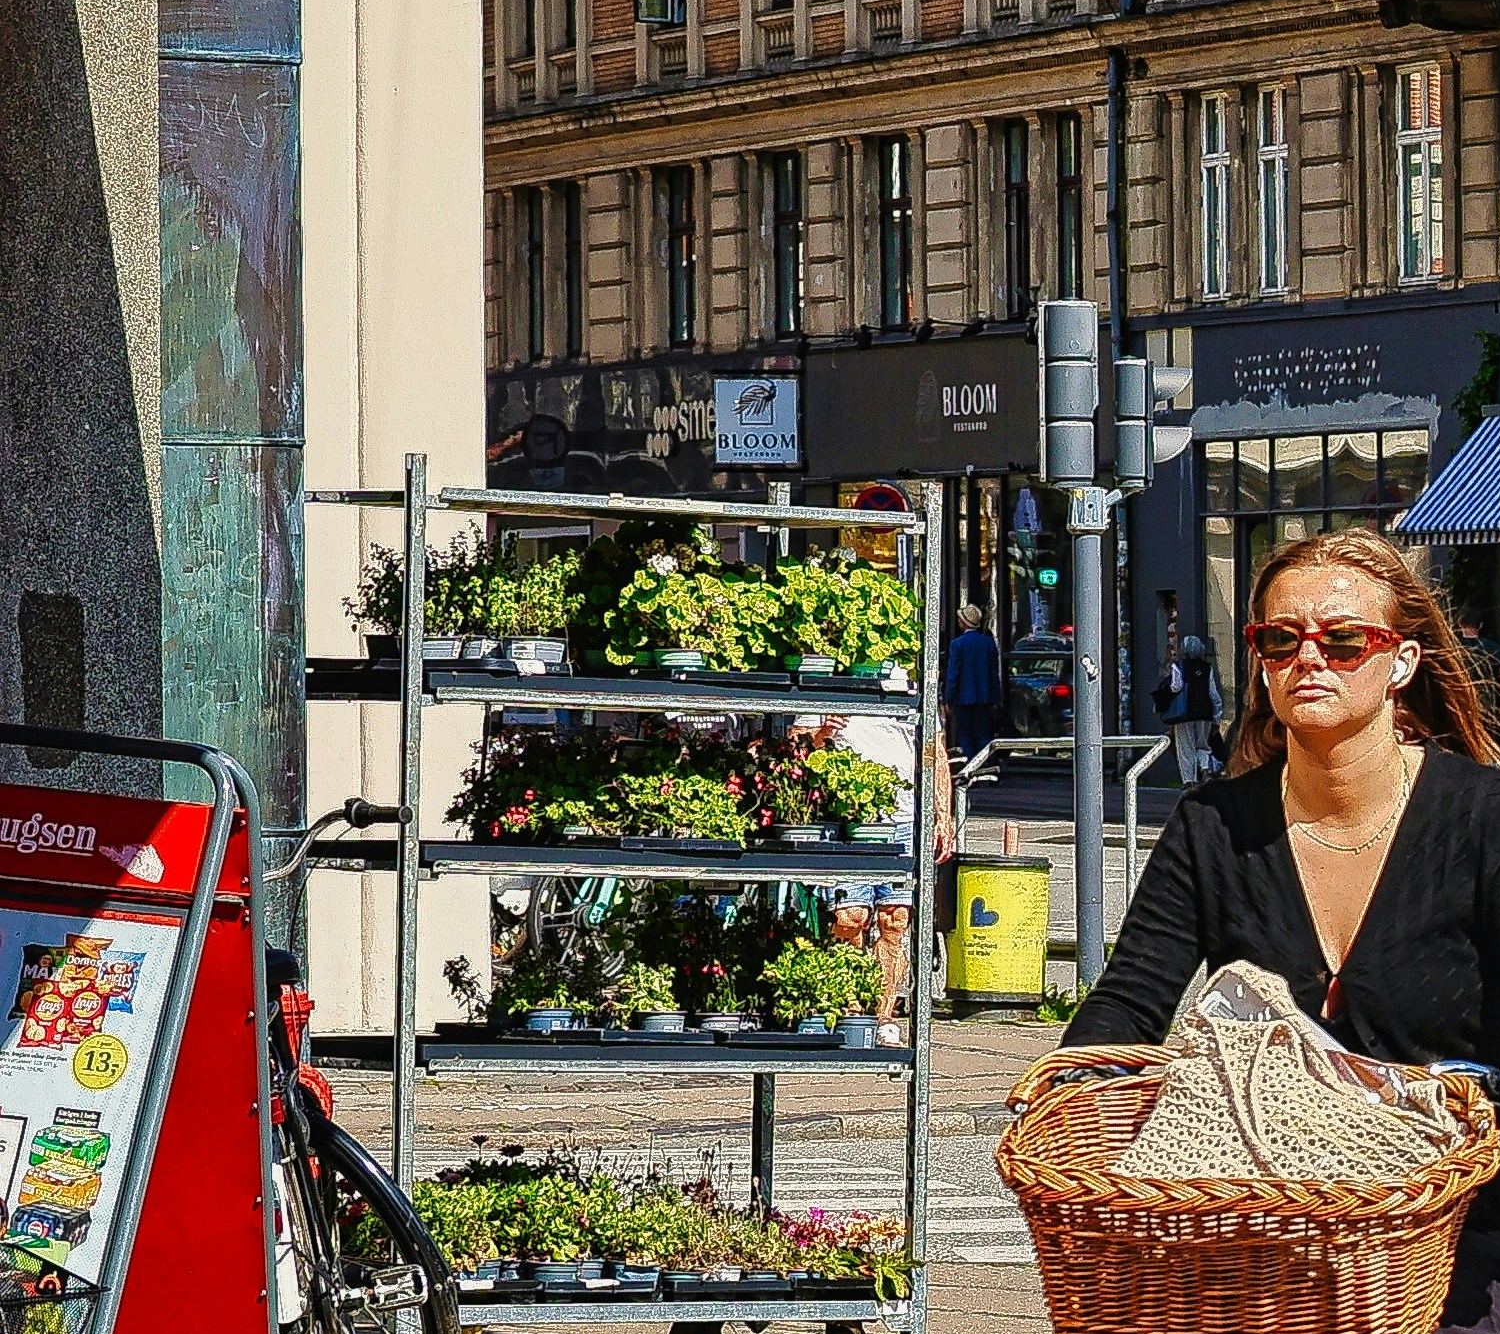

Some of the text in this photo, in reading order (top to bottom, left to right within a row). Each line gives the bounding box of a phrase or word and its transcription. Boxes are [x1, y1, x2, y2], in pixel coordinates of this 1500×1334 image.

[942, 383, 998, 417] BLOOM
[717, 432, 797, 450] BLOOM
[0, 813, 97, 854] ugsen
